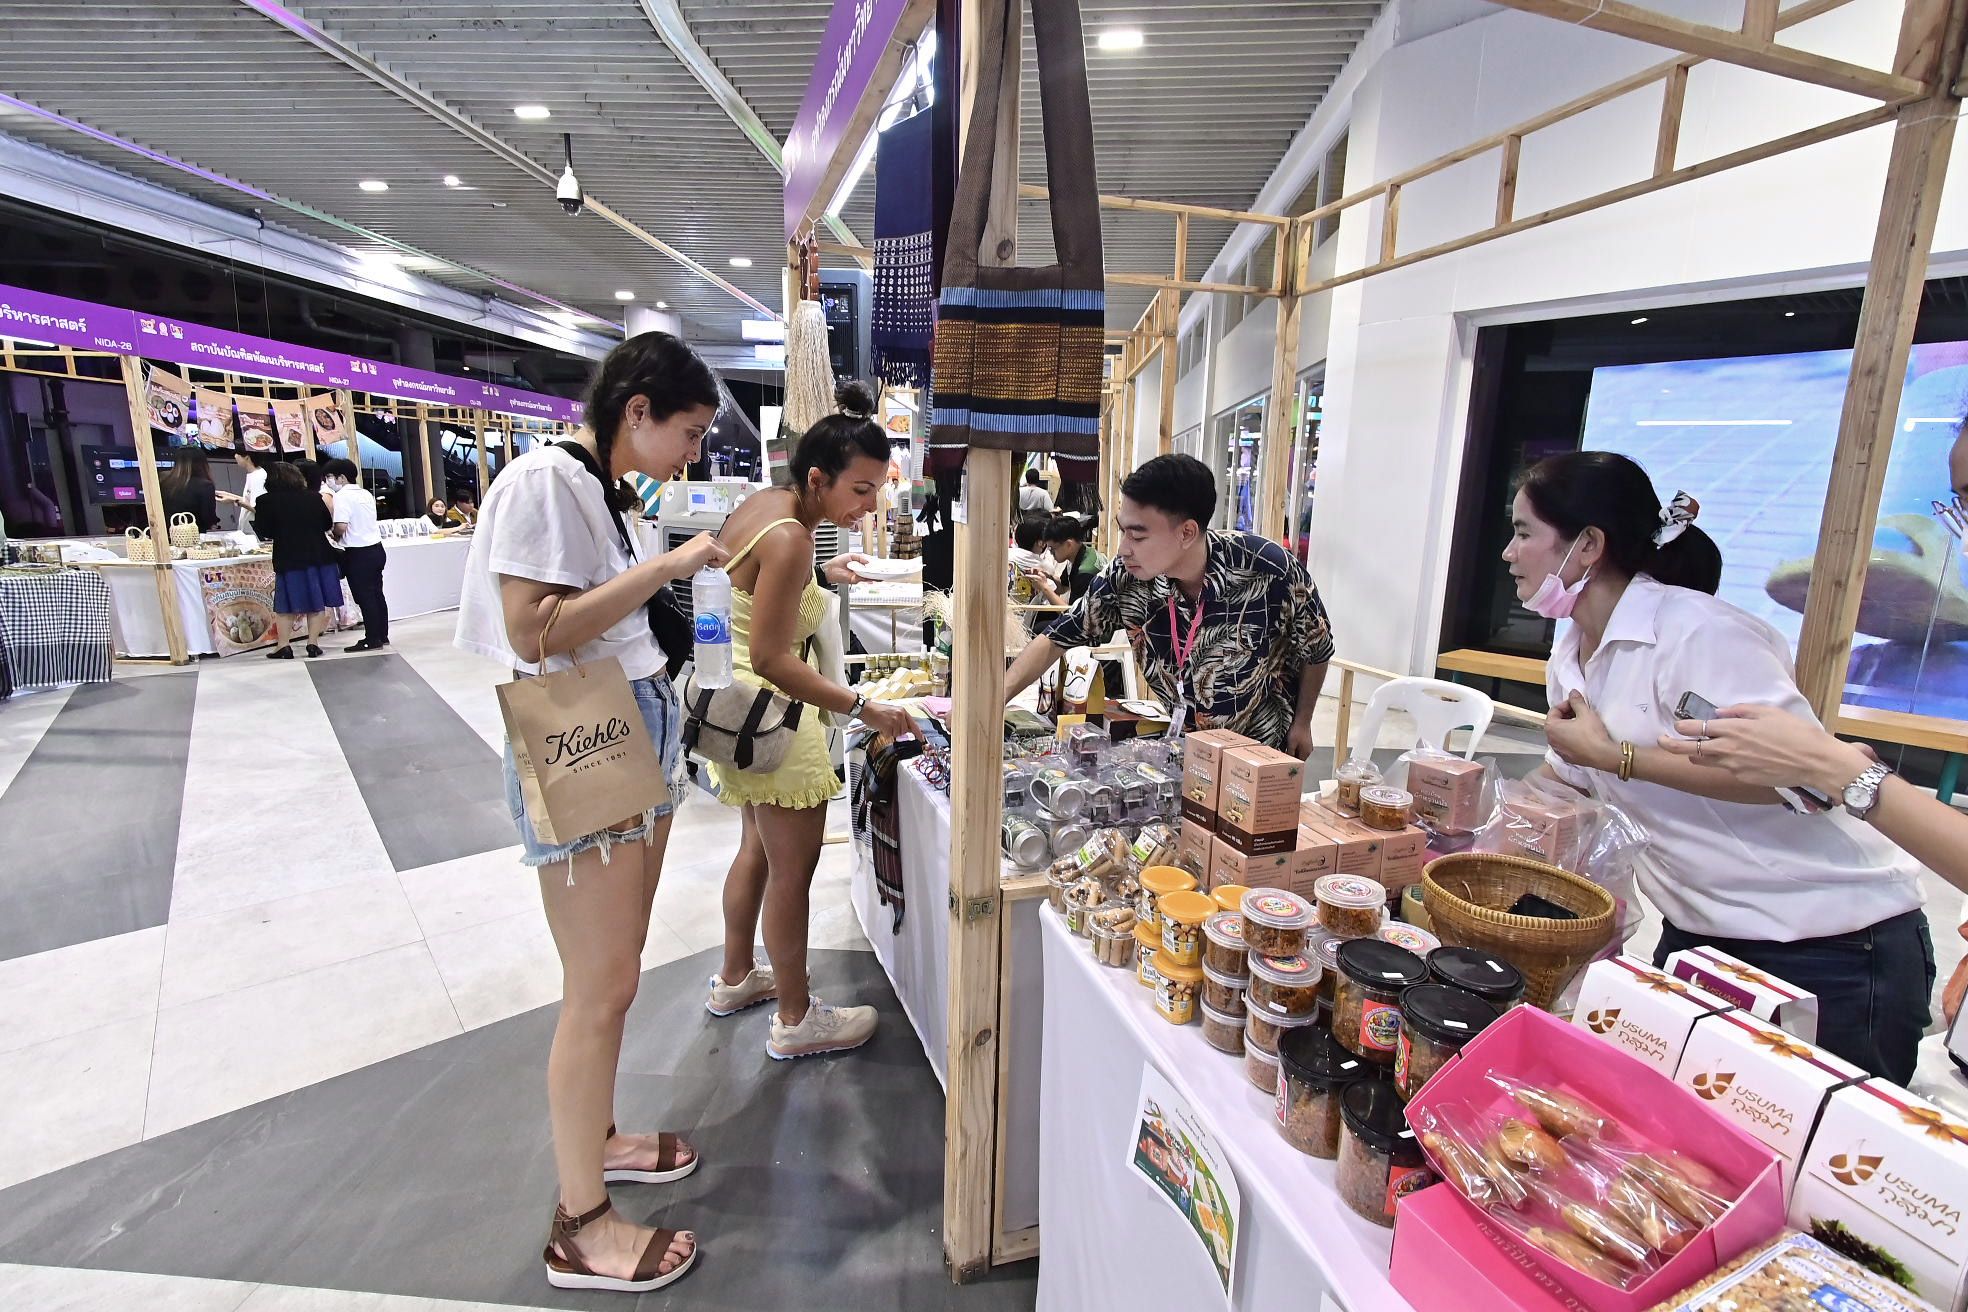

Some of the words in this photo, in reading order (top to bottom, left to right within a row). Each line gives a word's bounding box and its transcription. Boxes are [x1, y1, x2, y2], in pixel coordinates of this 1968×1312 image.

[811, 0, 878, 163] จุฬาลงกรณ์มหาวิทย
[545, 717, 631, 765] Kiehl's
[572, 760, 602, 774] SINCE
[606, 751, 627, 762] 1851
[1621, 1019, 1668, 1050] USUMA
[1736, 1086, 1794, 1123] USUMA
[1884, 1172, 1961, 1223] USUMA
